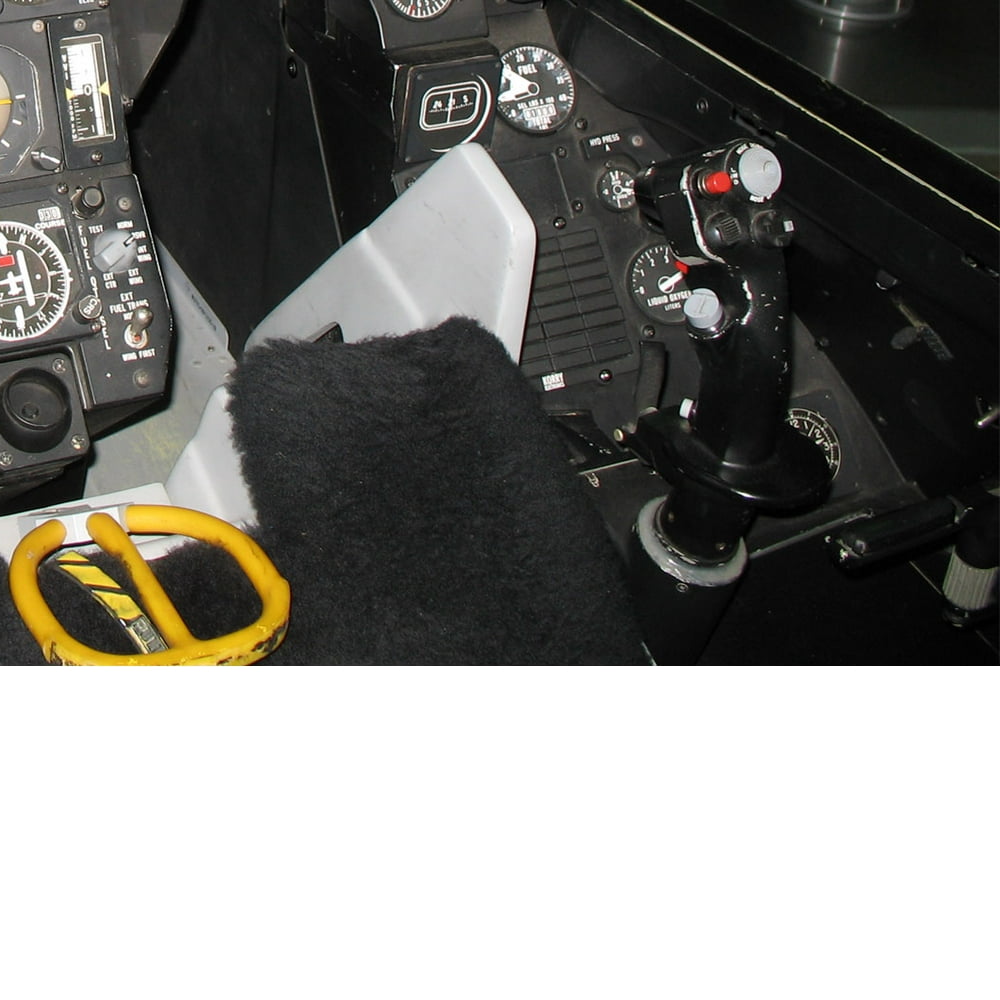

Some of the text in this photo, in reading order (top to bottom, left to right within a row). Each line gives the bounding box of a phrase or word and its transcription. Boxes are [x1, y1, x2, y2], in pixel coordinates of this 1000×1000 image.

[517, 64, 538, 76] FUEL
[83, 84, 92, 96] 0
[589, 133, 620, 147] HYD PRESS
[605, 144, 612, 152] A
[34, 219, 66, 231] COURSE
[88, 224, 104, 234] TEST
[649, 258, 656, 267] 2
[103, 272, 114, 282] EXT
[128, 268, 139, 277] EXT
[120, 291, 134, 302] EXT
[647, 294, 669, 307] LIQUID
[109, 303, 128, 315] FUEL
[138, 348, 156, 359] FIRST
[814, 428, 822, 438] 2
